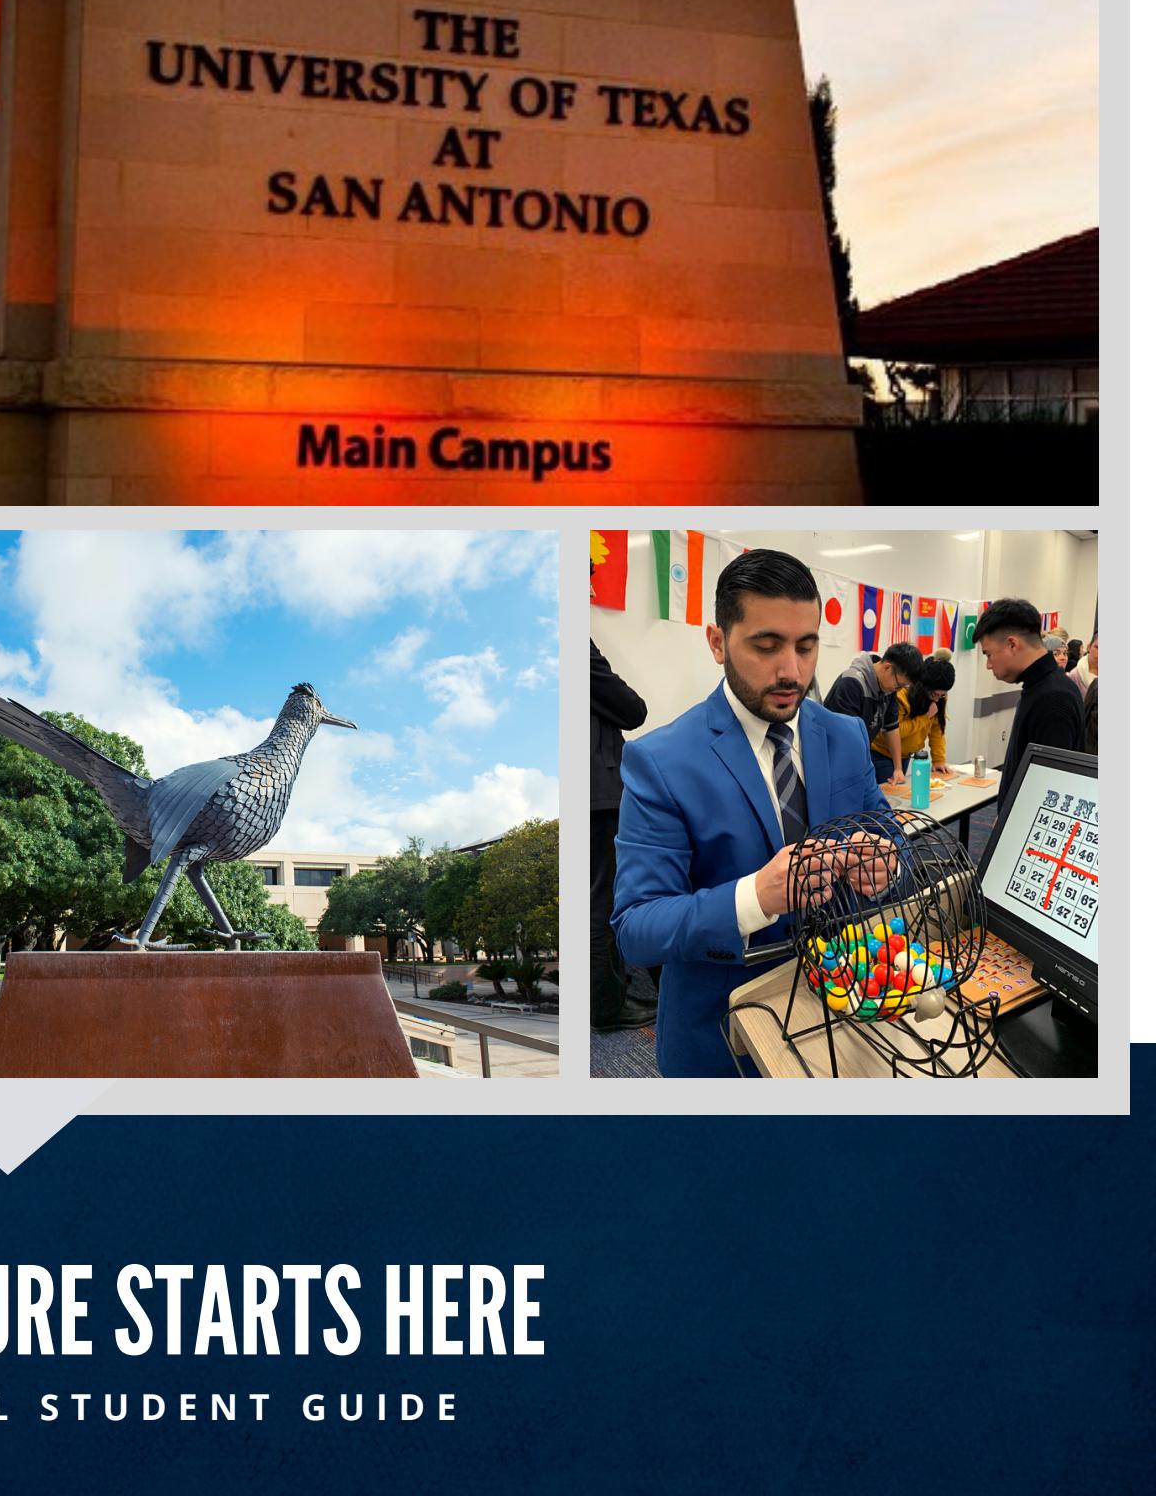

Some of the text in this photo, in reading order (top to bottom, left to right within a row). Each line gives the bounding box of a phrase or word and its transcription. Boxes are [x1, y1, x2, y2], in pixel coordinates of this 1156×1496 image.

[414, 9, 520, 58] THE
[146, 40, 751, 136] UNIVERSITY OF TEXAS
[433, 127, 500, 169] AT
[268, 172, 650, 238] SAN ANTONIO
[297, 424, 612, 482] Main Campus
[1038, 814, 1049, 825] 14
[1052, 820, 1065, 832] 29
[1043, 790, 1098, 821] BIN
[1033, 831, 1041, 841] 4
[1045, 836, 1057, 848] 18
[1078, 849, 1094, 862] 46
[1010, 880, 1088, 929] 12 23 47 73
[1019, 865, 1026, 874] 9
[1031, 871, 1044, 883] 27
[1064, 887, 1077, 900] 51
[1081, 895, 1096, 908] 67
